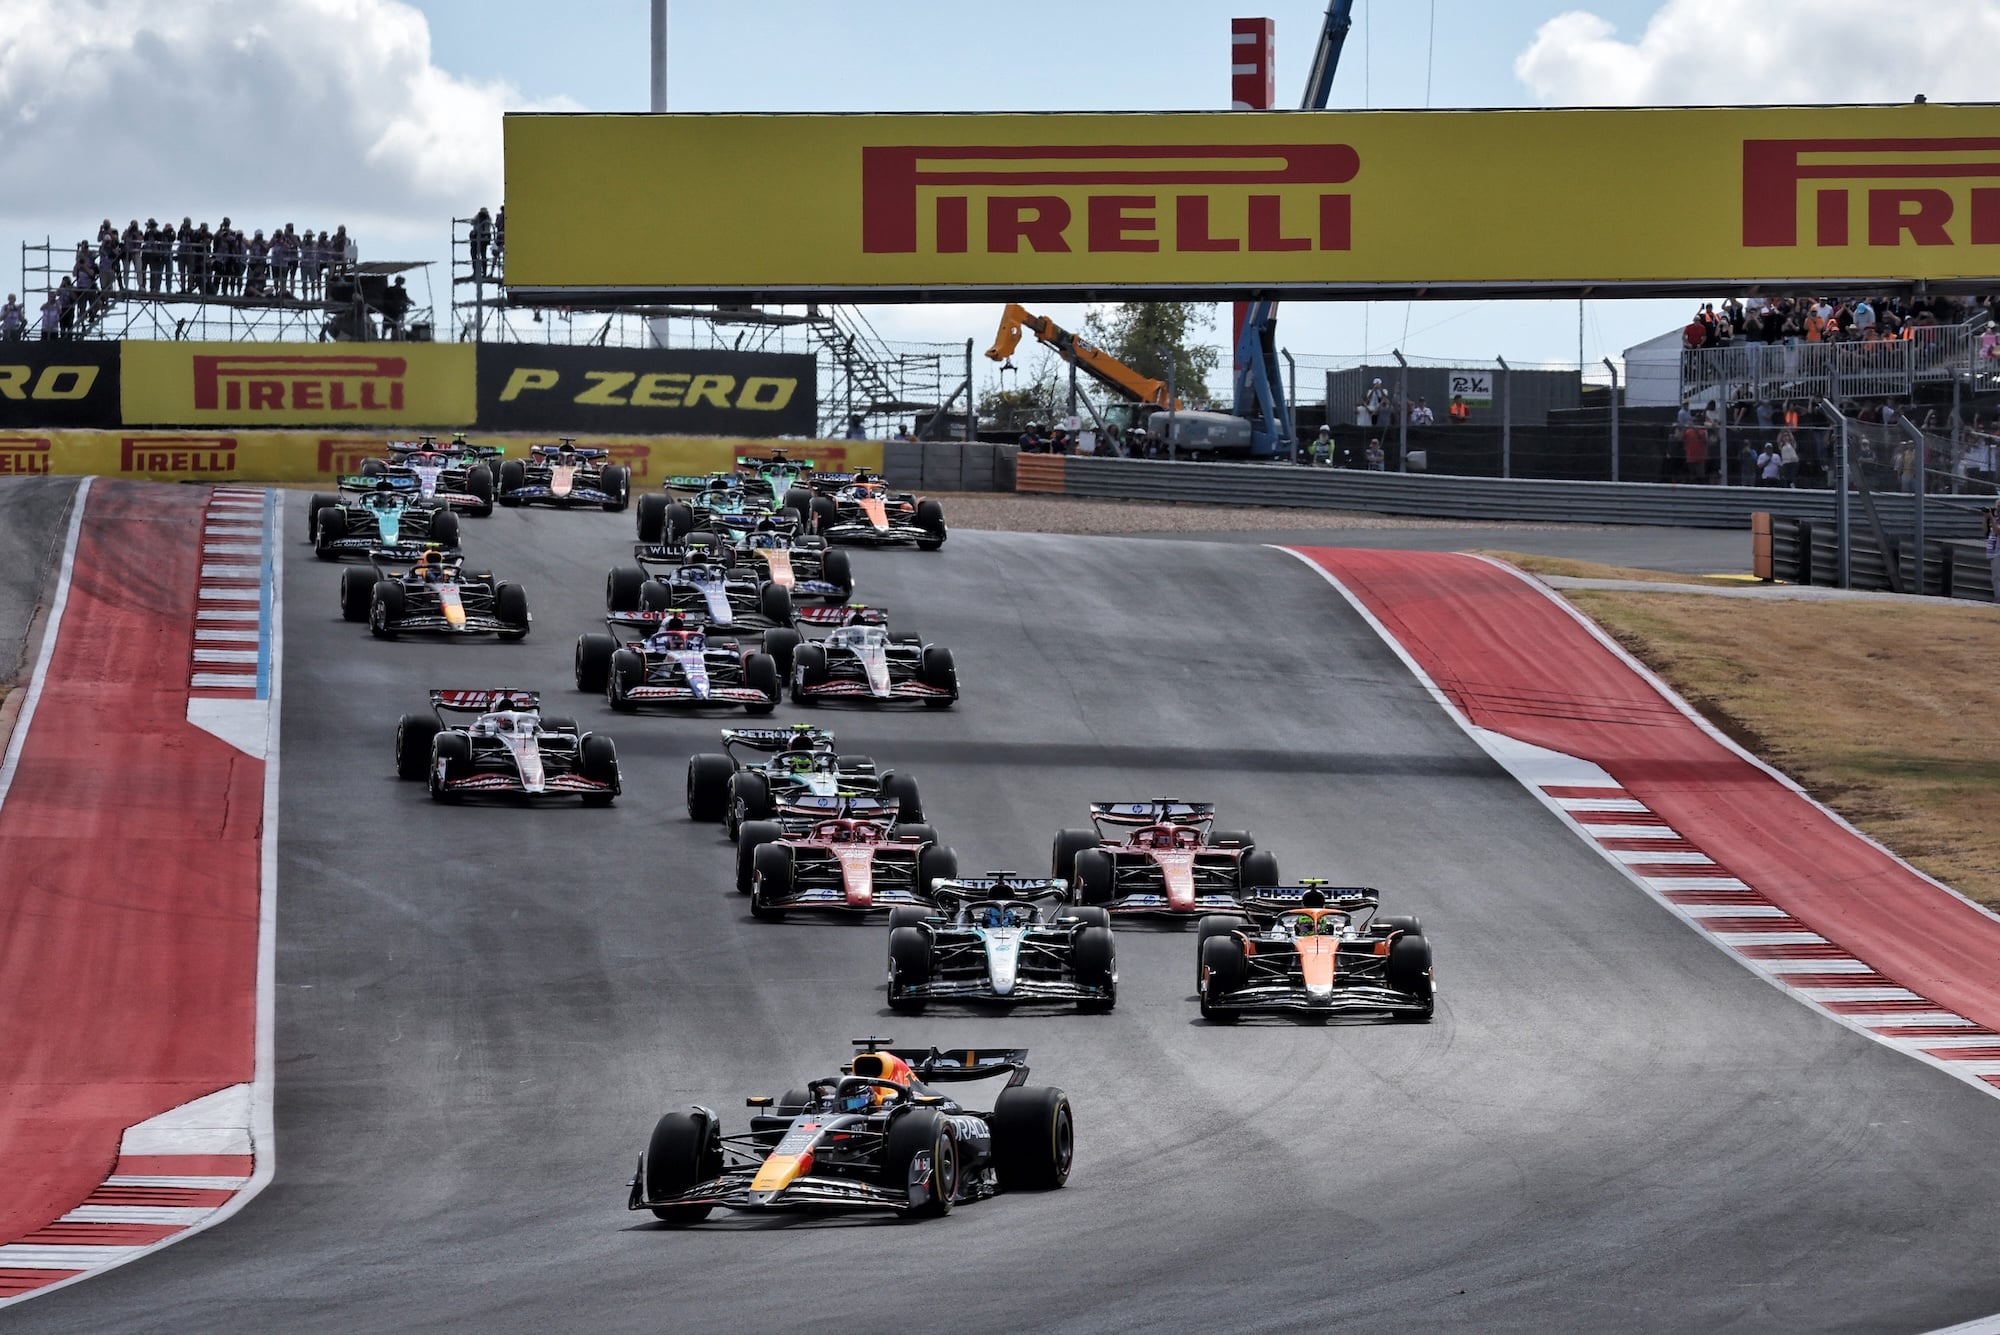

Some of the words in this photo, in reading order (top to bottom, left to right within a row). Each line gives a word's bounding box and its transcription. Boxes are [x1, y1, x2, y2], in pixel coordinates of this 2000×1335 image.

[862, 144, 1361, 254] PIRELLI
[193, 355, 407, 410] PIRELLI
[499, 368, 560, 402] P
[574, 371, 798, 411] ZERO
[121, 438, 238, 472] PIRELLI
